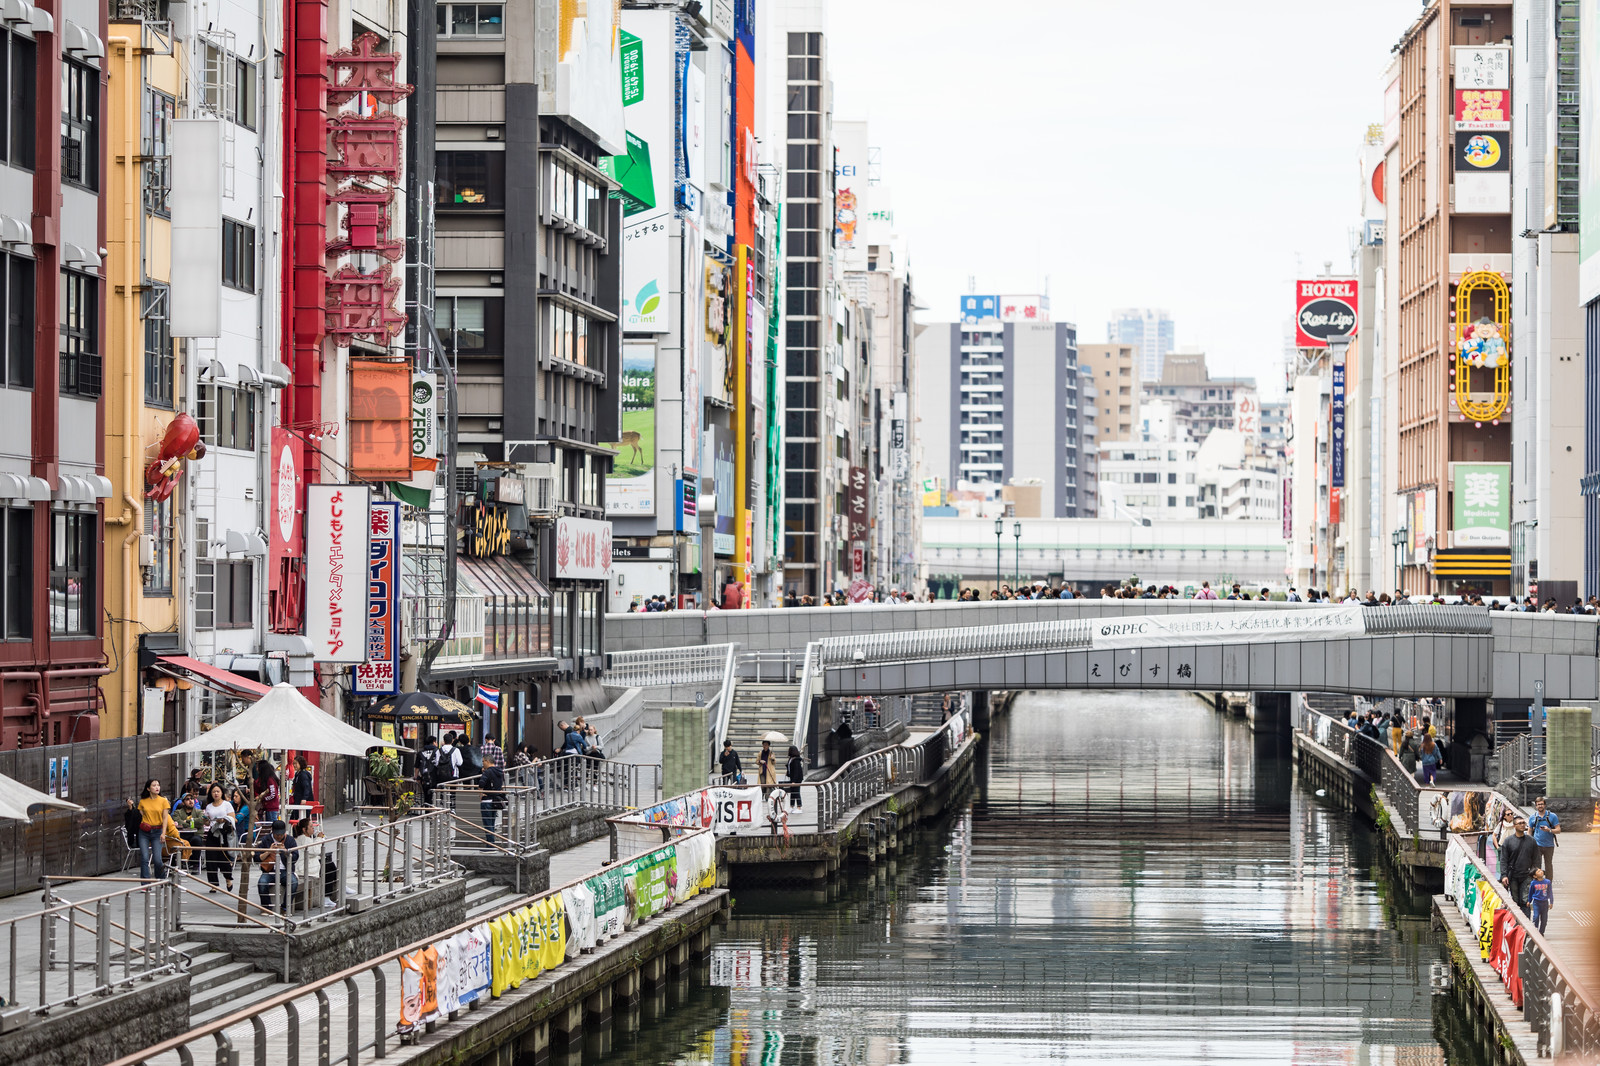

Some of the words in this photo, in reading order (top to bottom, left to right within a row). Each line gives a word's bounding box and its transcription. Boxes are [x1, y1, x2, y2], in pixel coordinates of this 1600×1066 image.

[1301, 283, 1354, 297] HOTEL
[1302, 311, 1328, 327] Rose
[1328, 311, 1354, 330] Lips
[1239, 396, 1255, 433] かに
[1464, 472, 1500, 508] 薬
[1463, 509, 1500, 517] Medicine
[611, 548, 631, 556] ilets
[329, 490, 344, 657] よしもとエンタメショップ
[369, 539, 390, 618] ダイコク
[357, 663, 393, 679] 免税
[1091, 662, 1193, 679] えびす橋
